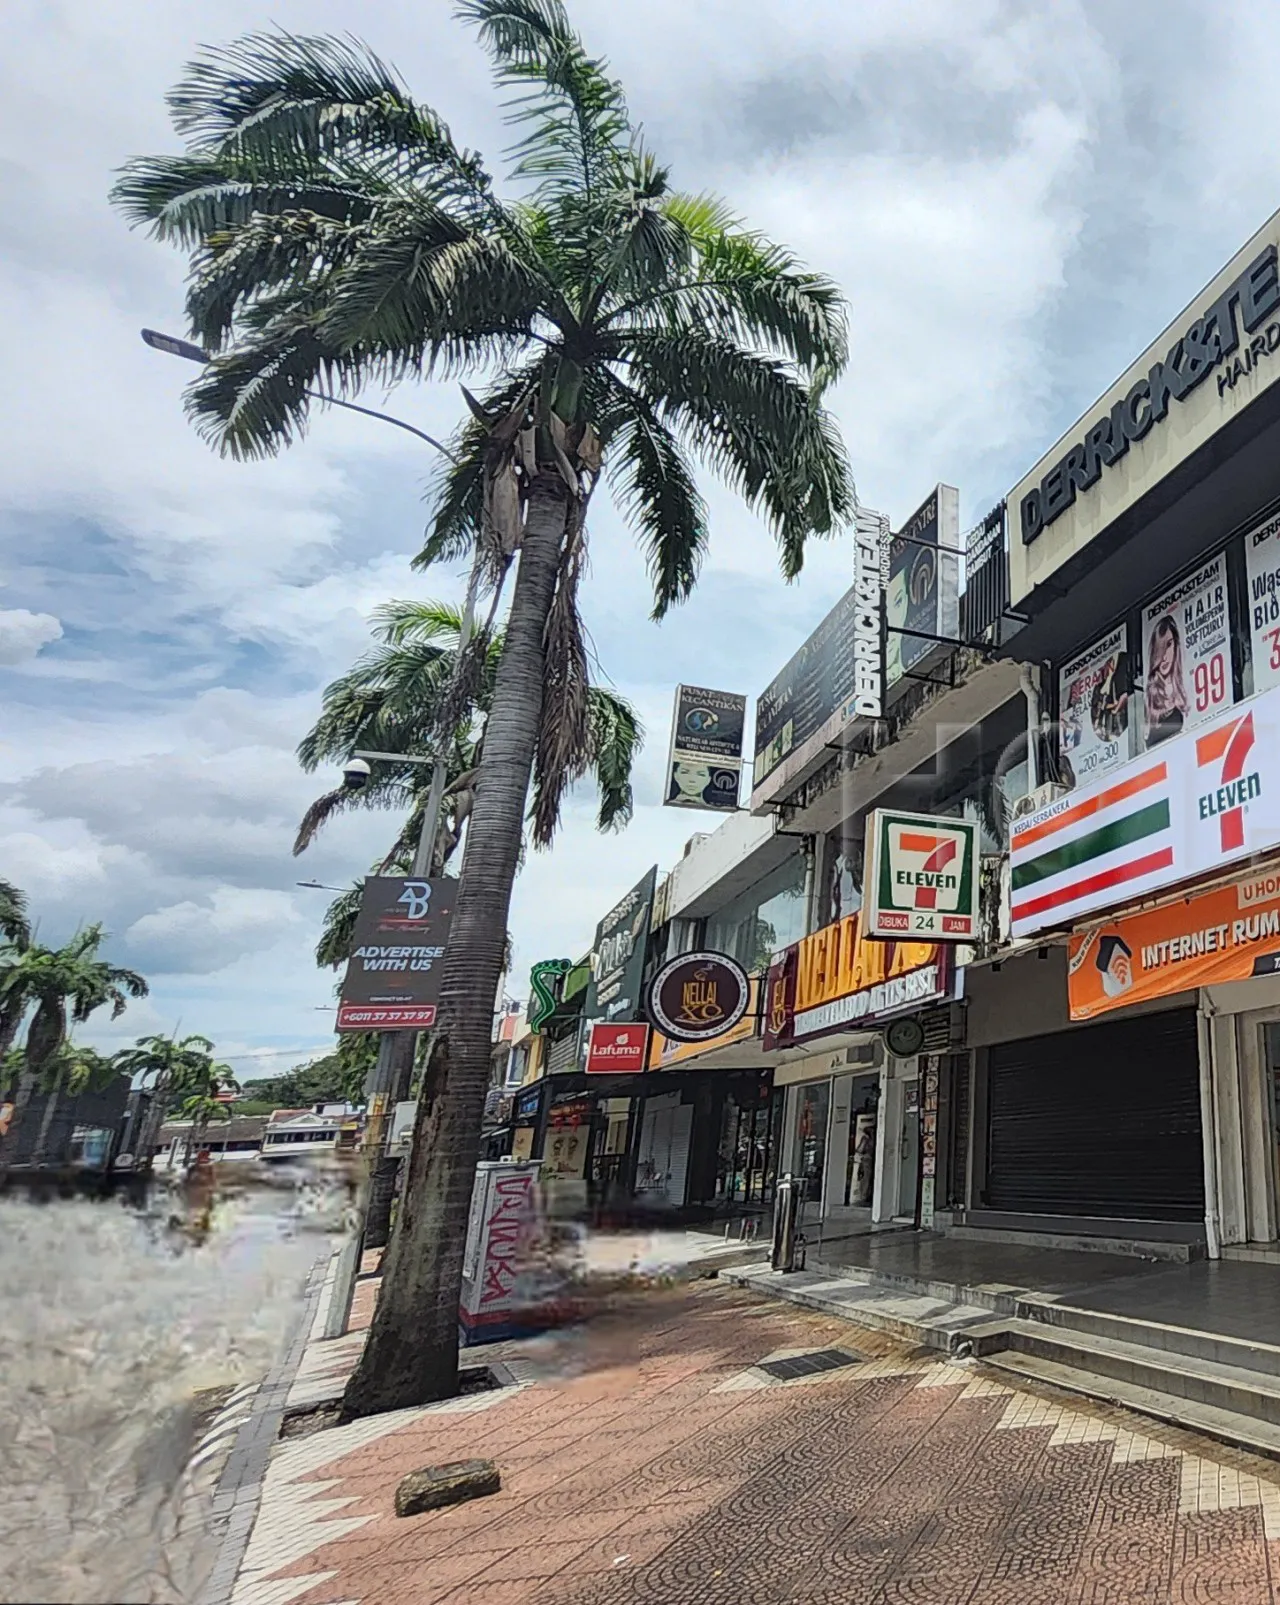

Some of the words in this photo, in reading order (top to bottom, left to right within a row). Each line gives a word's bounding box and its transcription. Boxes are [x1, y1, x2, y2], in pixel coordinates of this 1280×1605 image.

[853, 506, 882, 718] DERRICK&TEAM
[1184, 585, 1224, 625] HAIR
[1193, 652, 1226, 713] 99
[1243, 884, 1255, 902] U
[914, 915, 935, 930] 24
[949, 919, 967, 931] JAM
[351, 945, 446, 959] ADVERTISE
[1140, 920, 1229, 970] INTERNET
[362, 958, 407, 972] WITH
[409, 958, 434, 971] US
[683, 981, 717, 1007] NELLAI
[592, 1043, 641, 1056] Lafuma
